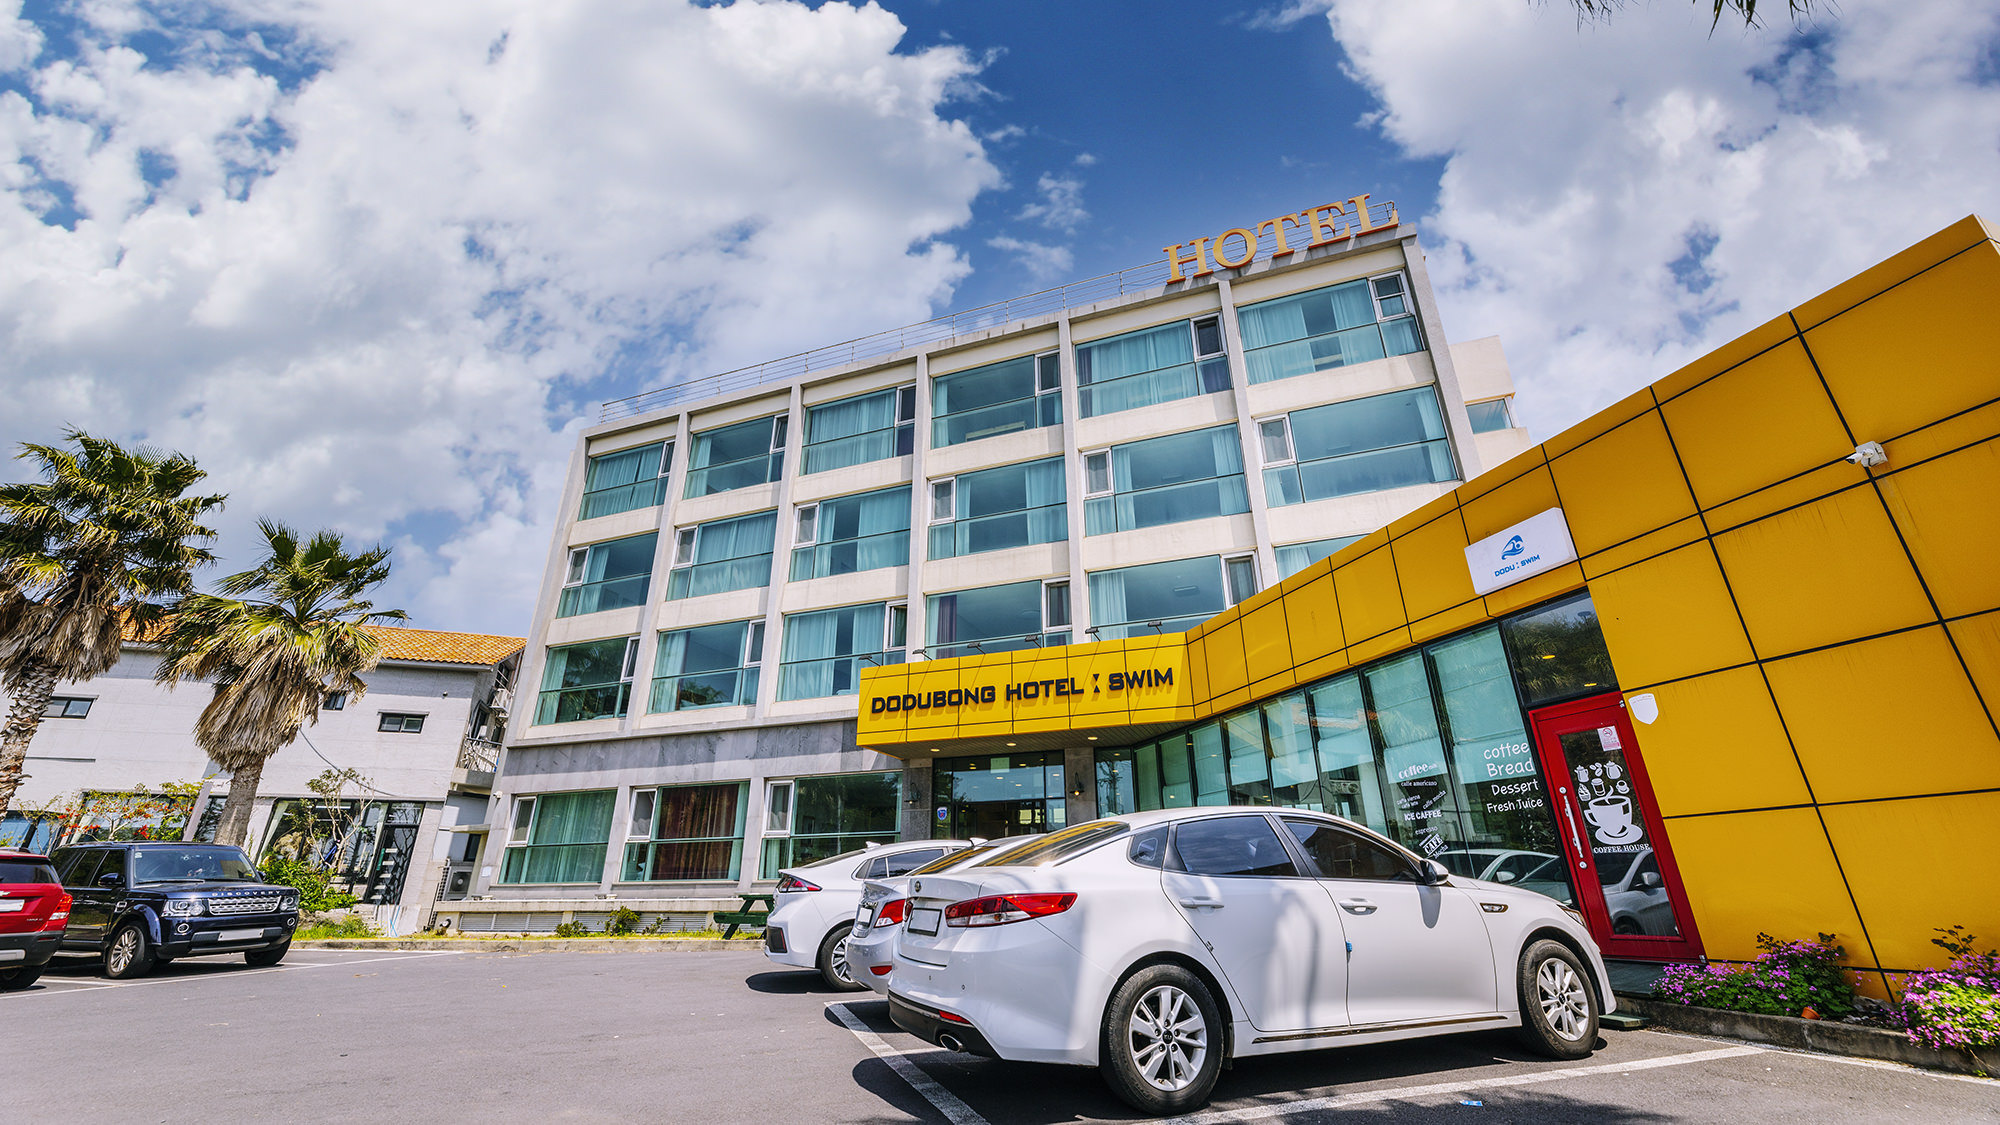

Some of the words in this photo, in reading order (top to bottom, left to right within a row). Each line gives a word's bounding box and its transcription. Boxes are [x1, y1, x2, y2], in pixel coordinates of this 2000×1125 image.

[1162, 193, 1399, 284] HOTEL
[1494, 564, 1515, 576] DODU
[1520, 554, 1540, 566] SWIM
[871, 685, 996, 714] DODUBONG
[1005, 677, 1084, 702] HOTEL
[1108, 667, 1174, 690] SWIM
[1483, 742, 1530, 760] coffee
[1398, 763, 1429, 779] coffee
[1486, 757, 1535, 777] Bread
[1491, 778, 1539, 796] Dessert
[1486, 801, 1516, 813] Fresh
[1516, 797, 1544, 810] Juice
[1404, 812, 1416, 821] ICE
[1415, 809, 1442, 820] CAFFEE
[1424, 835, 1443, 855] CAFE
[1593, 845, 1622, 854] COFFEE
[1623, 843, 1651, 852] HOUSE
